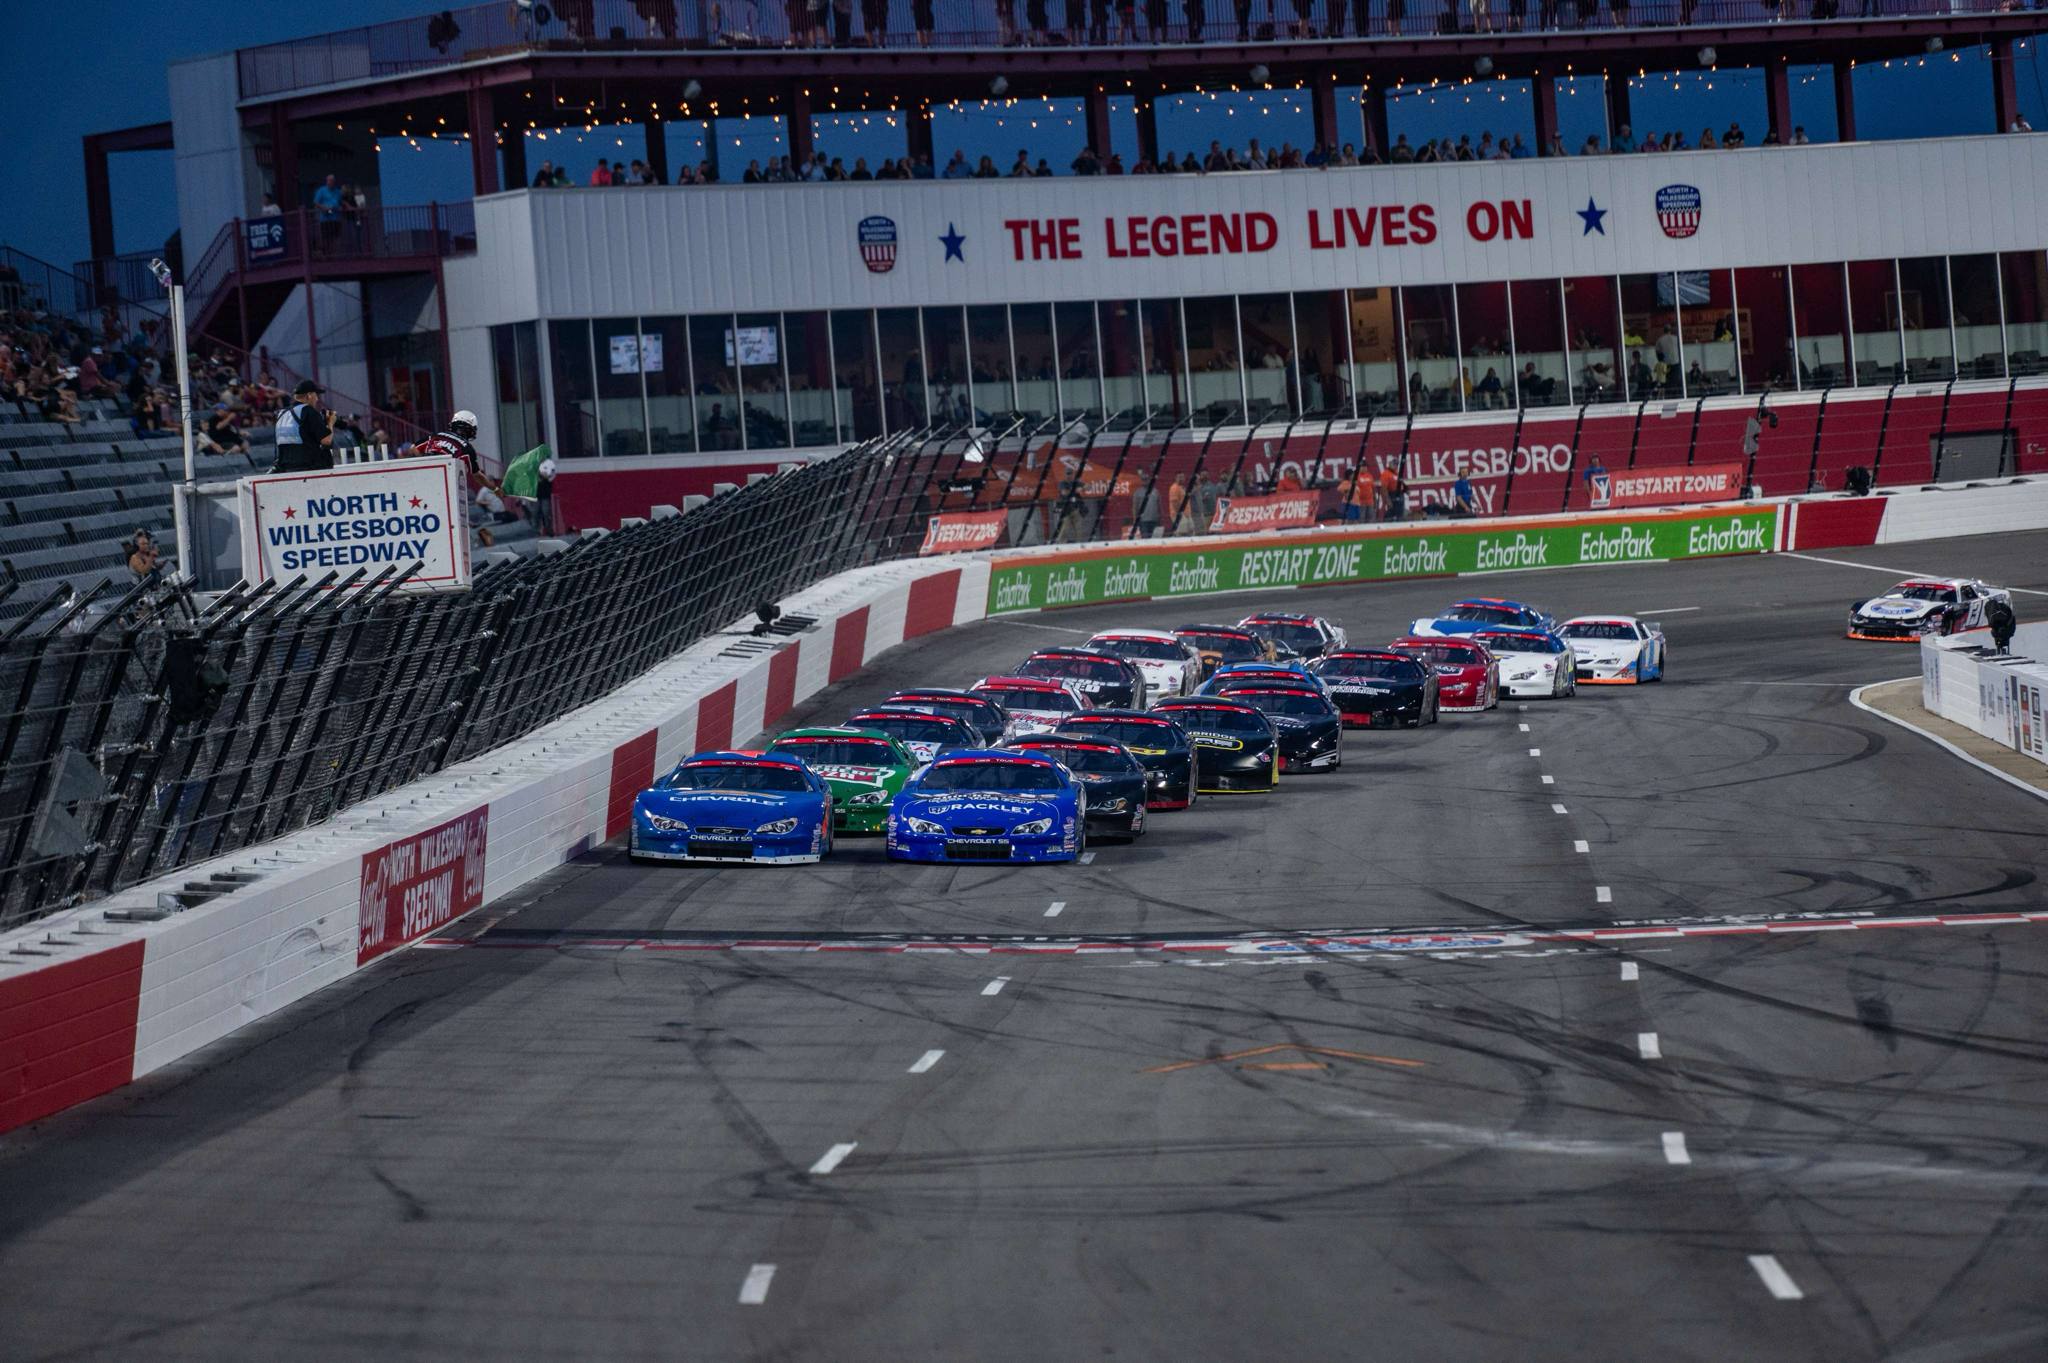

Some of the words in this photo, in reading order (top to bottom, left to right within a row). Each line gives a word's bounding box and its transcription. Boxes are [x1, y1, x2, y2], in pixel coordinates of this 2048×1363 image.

[1005, 218, 1082, 261] THE
[1105, 211, 1279, 259] LEGEND
[1308, 203, 1438, 250] LIVES
[1466, 199, 1535, 242] ON
[1615, 477, 1682, 496] RESTART
[1684, 474, 1727, 493] ZONE
[307, 492, 398, 518] NORTH
[268, 514, 440, 546] WILKESBORO
[1580, 527, 1654, 561] EchoPark
[1689, 519, 1765, 554] EchoPark
[282, 539, 431, 570] SPEEDWAY
[1239, 549, 1311, 586] RESTART
[1313, 544, 1362, 580] ZONE
[1384, 540, 1447, 575] EchoPark
[1477, 533, 1548, 569] EchoPark
[996, 571, 1031, 608] EchoPark
[1046, 567, 1087, 604] EchoPark
[1104, 559, 1151, 597] EchoPark
[1170, 556, 1219, 592] EchoPark
[669, 796, 788, 806] CHEVROLET
[951, 803, 1033, 814] RACKLEY
[391, 844, 416, 887] NORTH
[421, 821, 466, 873] WILKESBORO
[402, 869, 454, 940] SPEEDWAY
